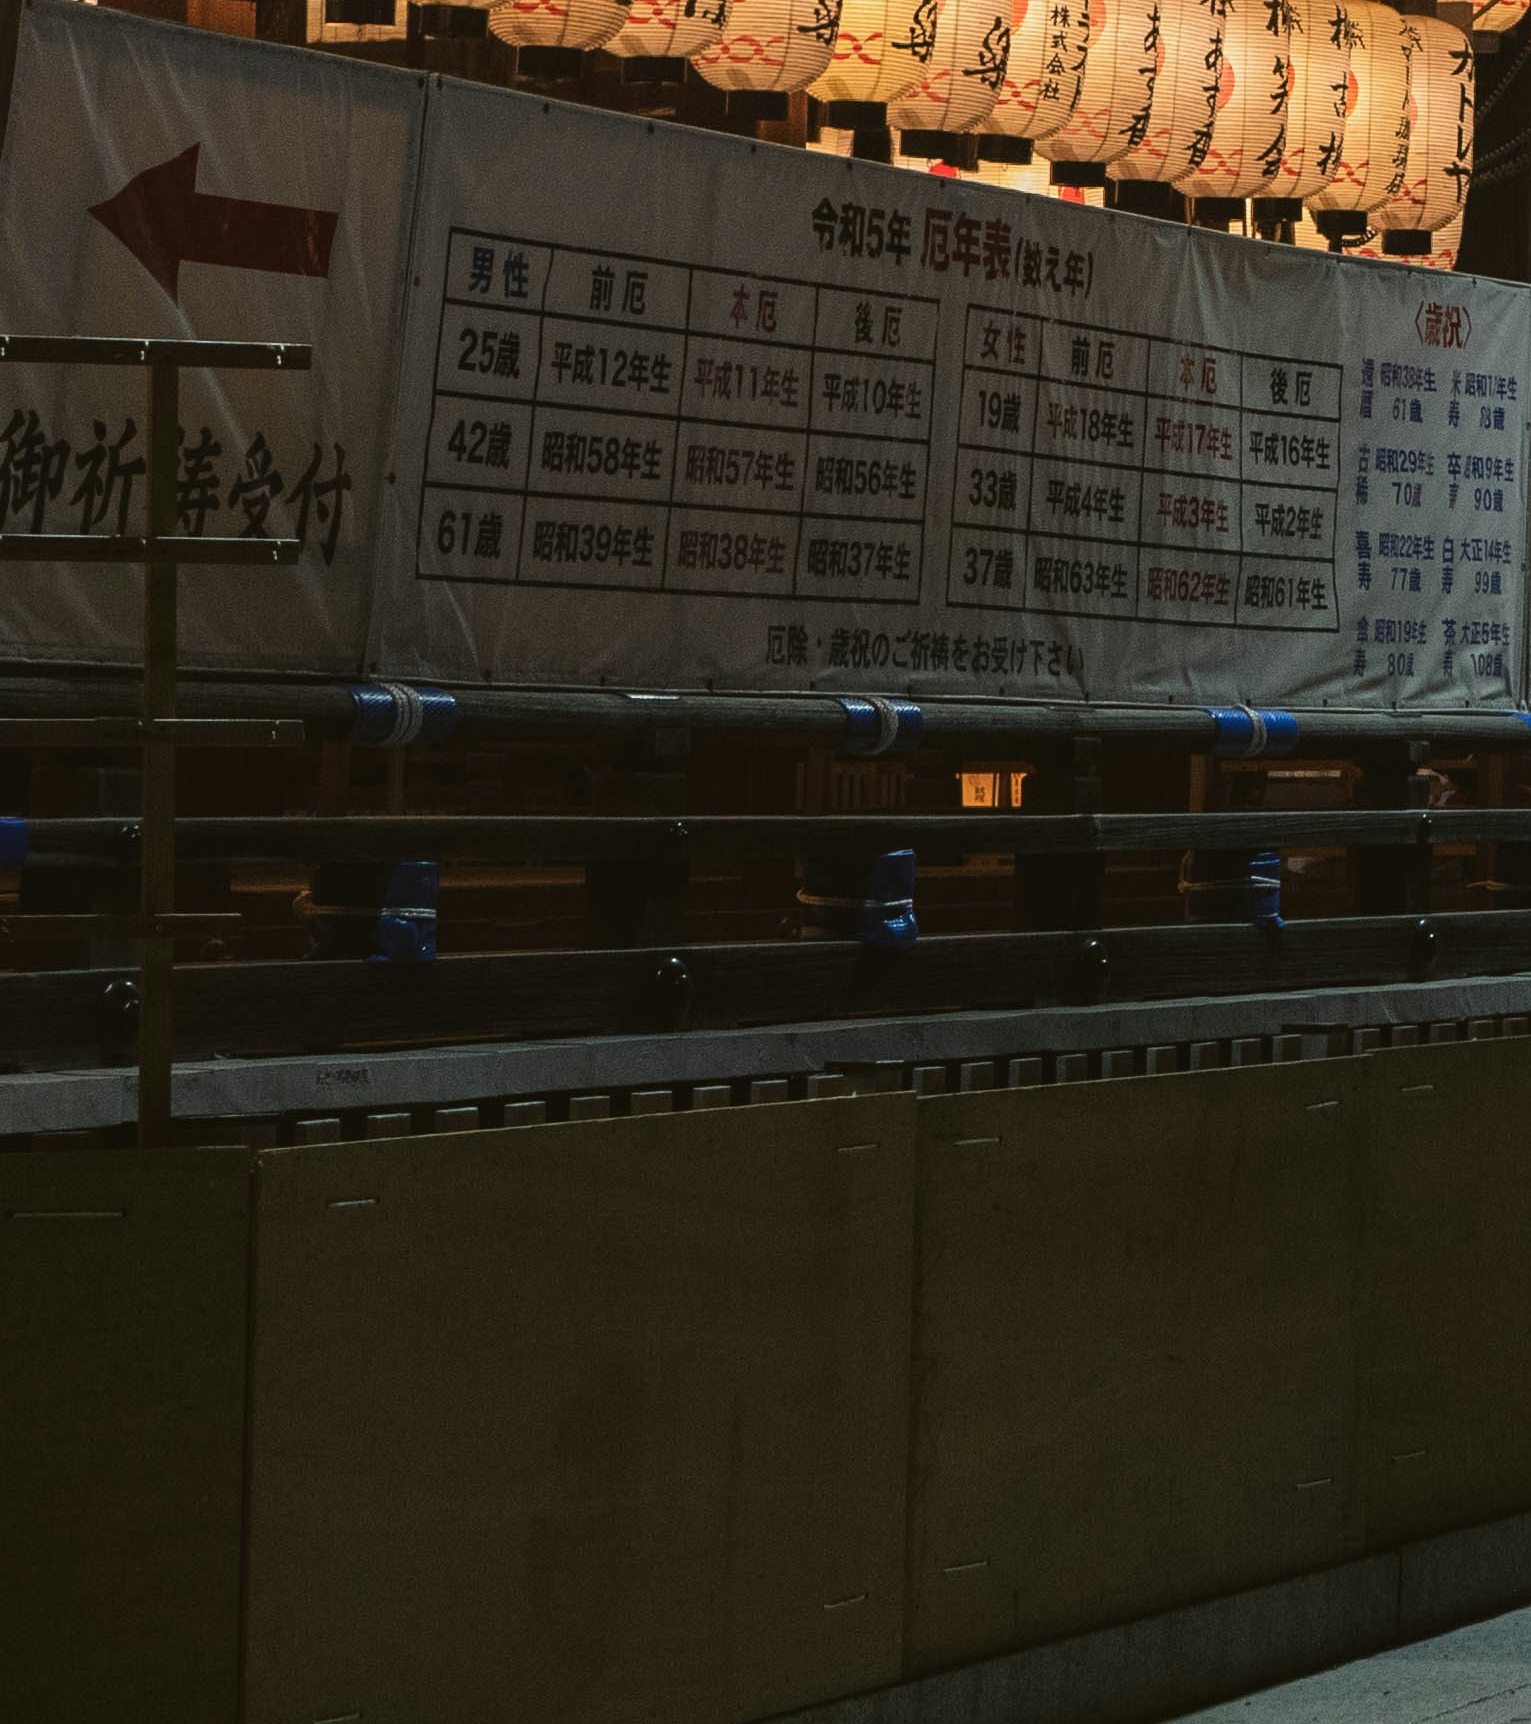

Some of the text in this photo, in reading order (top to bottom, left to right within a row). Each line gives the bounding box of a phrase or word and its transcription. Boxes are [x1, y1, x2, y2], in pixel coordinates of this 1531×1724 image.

[1040, 4, 1071, 103] 株式会社
[812, 197, 911, 259] 令和5年
[458, 328, 921, 419] 25歳 平成12年生 平成11年生 平成10年生
[448, 421, 916, 500] 42歳 昭和58年生 昭和57年生 昭和56年生
[977, 389, 1331, 471] 19歳 平成18年生 平成17年生 平成16年生
[968, 469, 1323, 541] 33歳 平成4年生 平成3年生 平成2年生
[1473, 486, 1504, 512] 90歳
[438, 510, 910, 581] 61歳 昭和39年生 昭和38年生 昭和37年生
[1378, 531, 1435, 561] 昭和22年生
[1461, 538, 1512, 565] 大正14年生
[963, 548, 1328, 611] 37歳 昭和63年生 昭和62年生 昭和61年生
[1390, 565, 1502, 595] 77歳 99歳
[1460, 619, 1510, 646] 大正5年生
